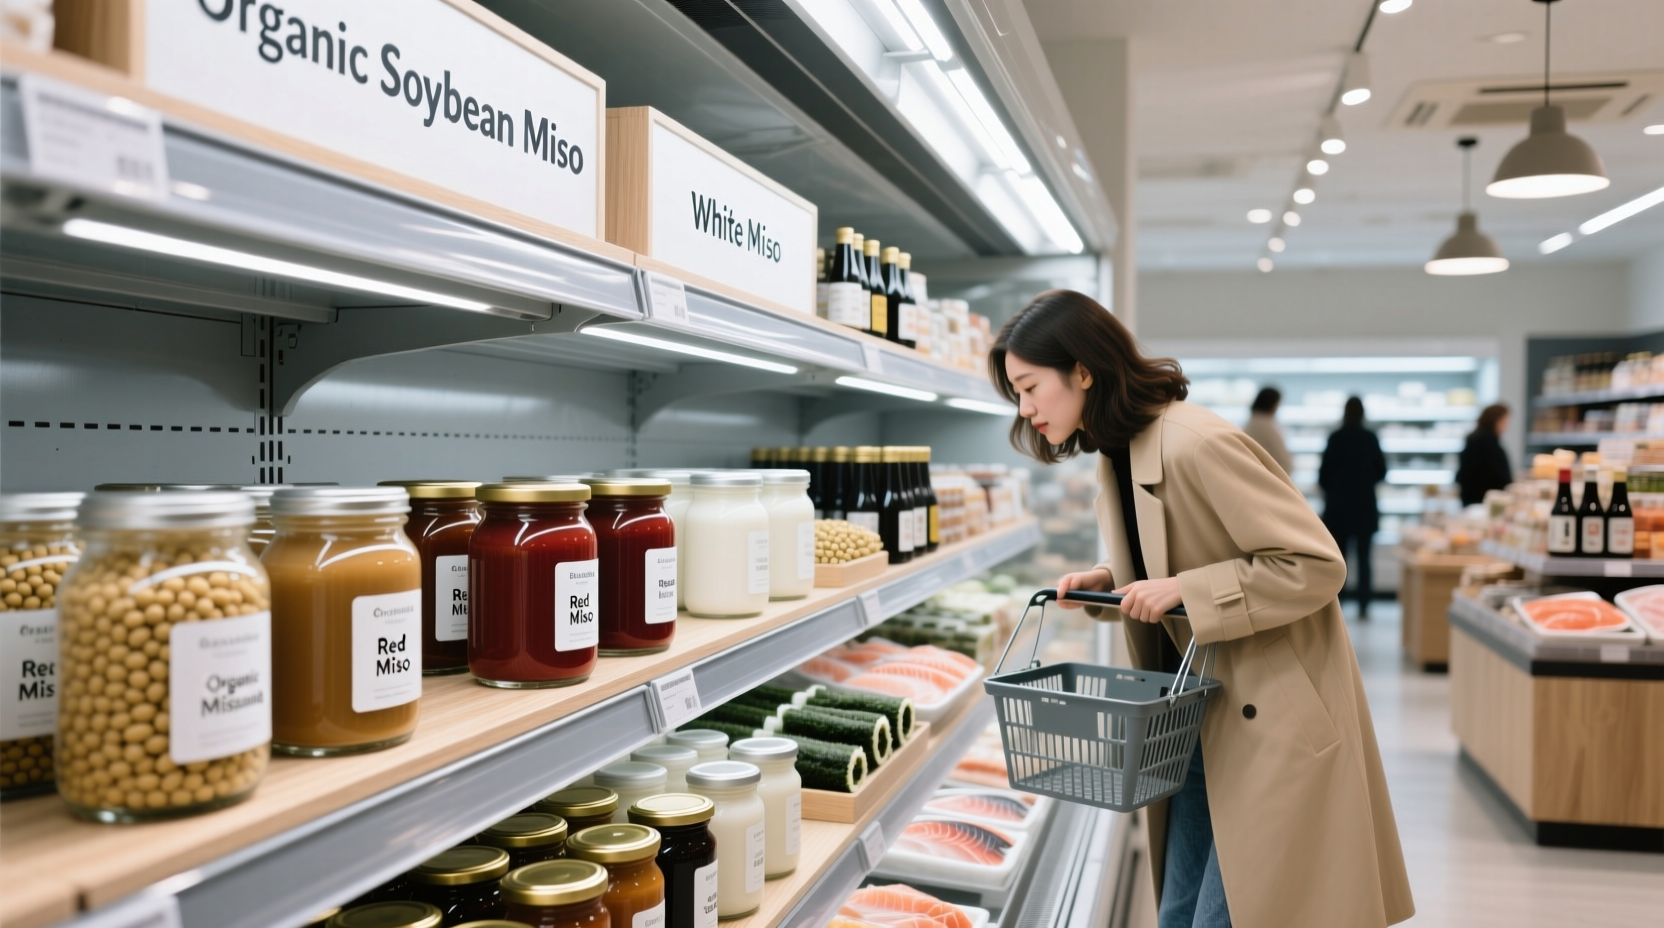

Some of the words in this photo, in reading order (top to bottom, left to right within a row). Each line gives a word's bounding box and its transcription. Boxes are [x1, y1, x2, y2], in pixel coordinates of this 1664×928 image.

[380, 43, 515, 148] Soybean
[523, 108, 585, 175] Miso
[691, 190, 744, 247] White
[747, 217, 782, 264] Miso
[452, 588, 467, 601] Re
[569, 592, 589, 609] Red
[569, 609, 593, 625] Miso
[378, 633, 406, 655] Red
[376, 656, 411, 677] Miso
[18, 680, 55, 701] Mis
